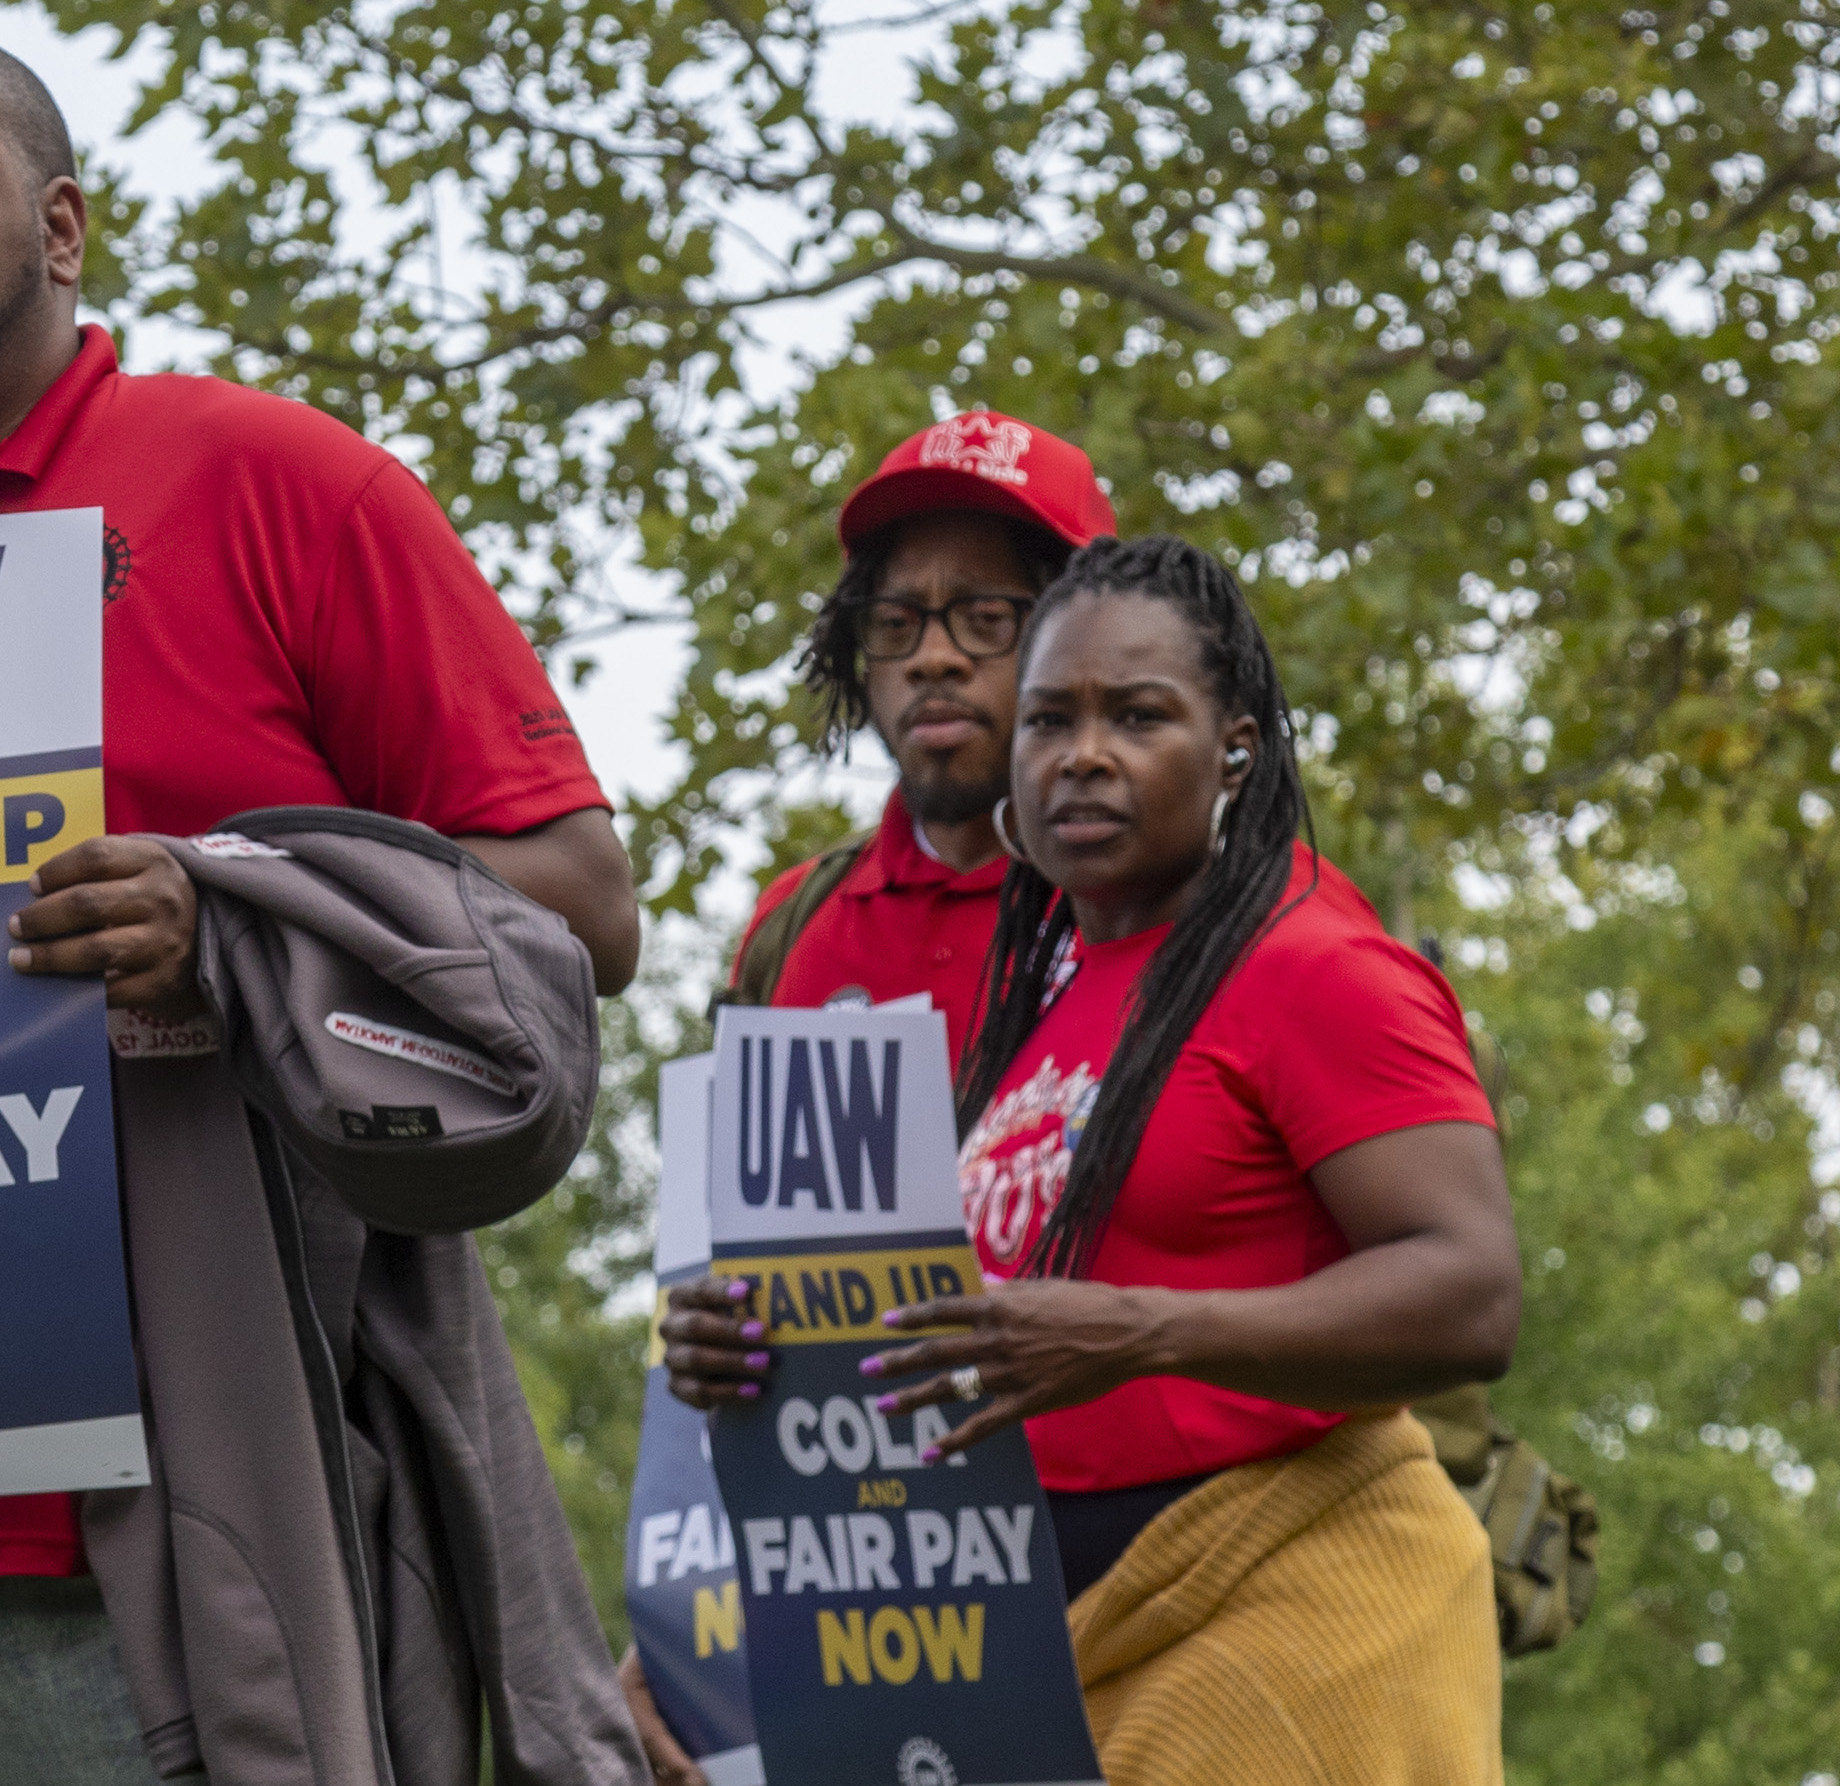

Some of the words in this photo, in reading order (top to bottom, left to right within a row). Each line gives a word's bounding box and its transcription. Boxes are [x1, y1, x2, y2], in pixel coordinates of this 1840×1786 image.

[738, 1036, 902, 1213] UAW
[726, 1266, 876, 1331] TAND
[776, 1394, 969, 1478] COLA
[857, 1478, 908, 1509] AND
[636, 1502, 737, 1588] FAI
[741, 1511, 902, 1596] FAIR
[904, 1504, 1036, 1589] PAY
[816, 1602, 986, 1687] NOW
